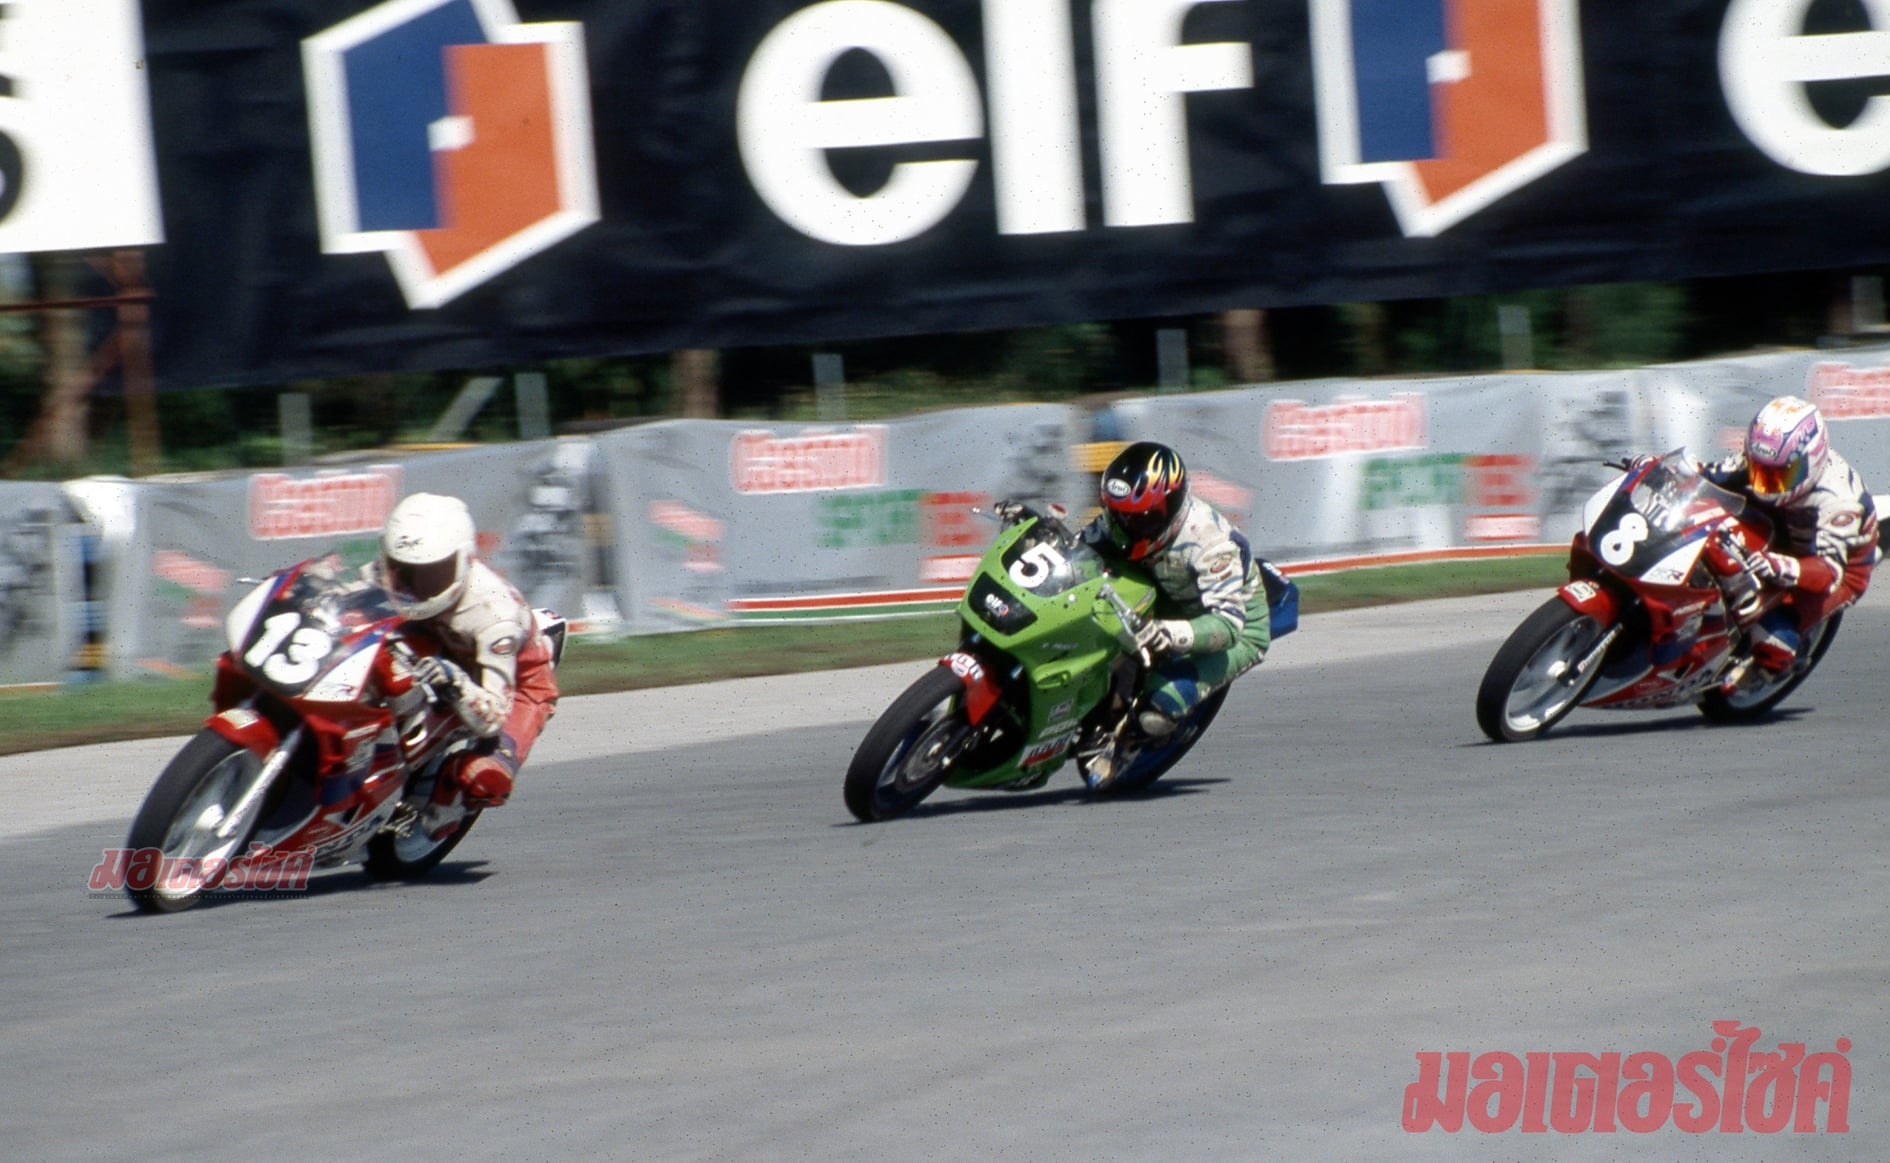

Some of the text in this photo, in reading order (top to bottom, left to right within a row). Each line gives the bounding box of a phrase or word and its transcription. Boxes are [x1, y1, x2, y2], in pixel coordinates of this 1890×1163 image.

[736, 0, 1254, 245] elf
[1109, 480, 1130, 495] Arai
[1009, 541, 1066, 588] 5
[1600, 513, 1649, 566] 8
[244, 612, 333, 684] 13
